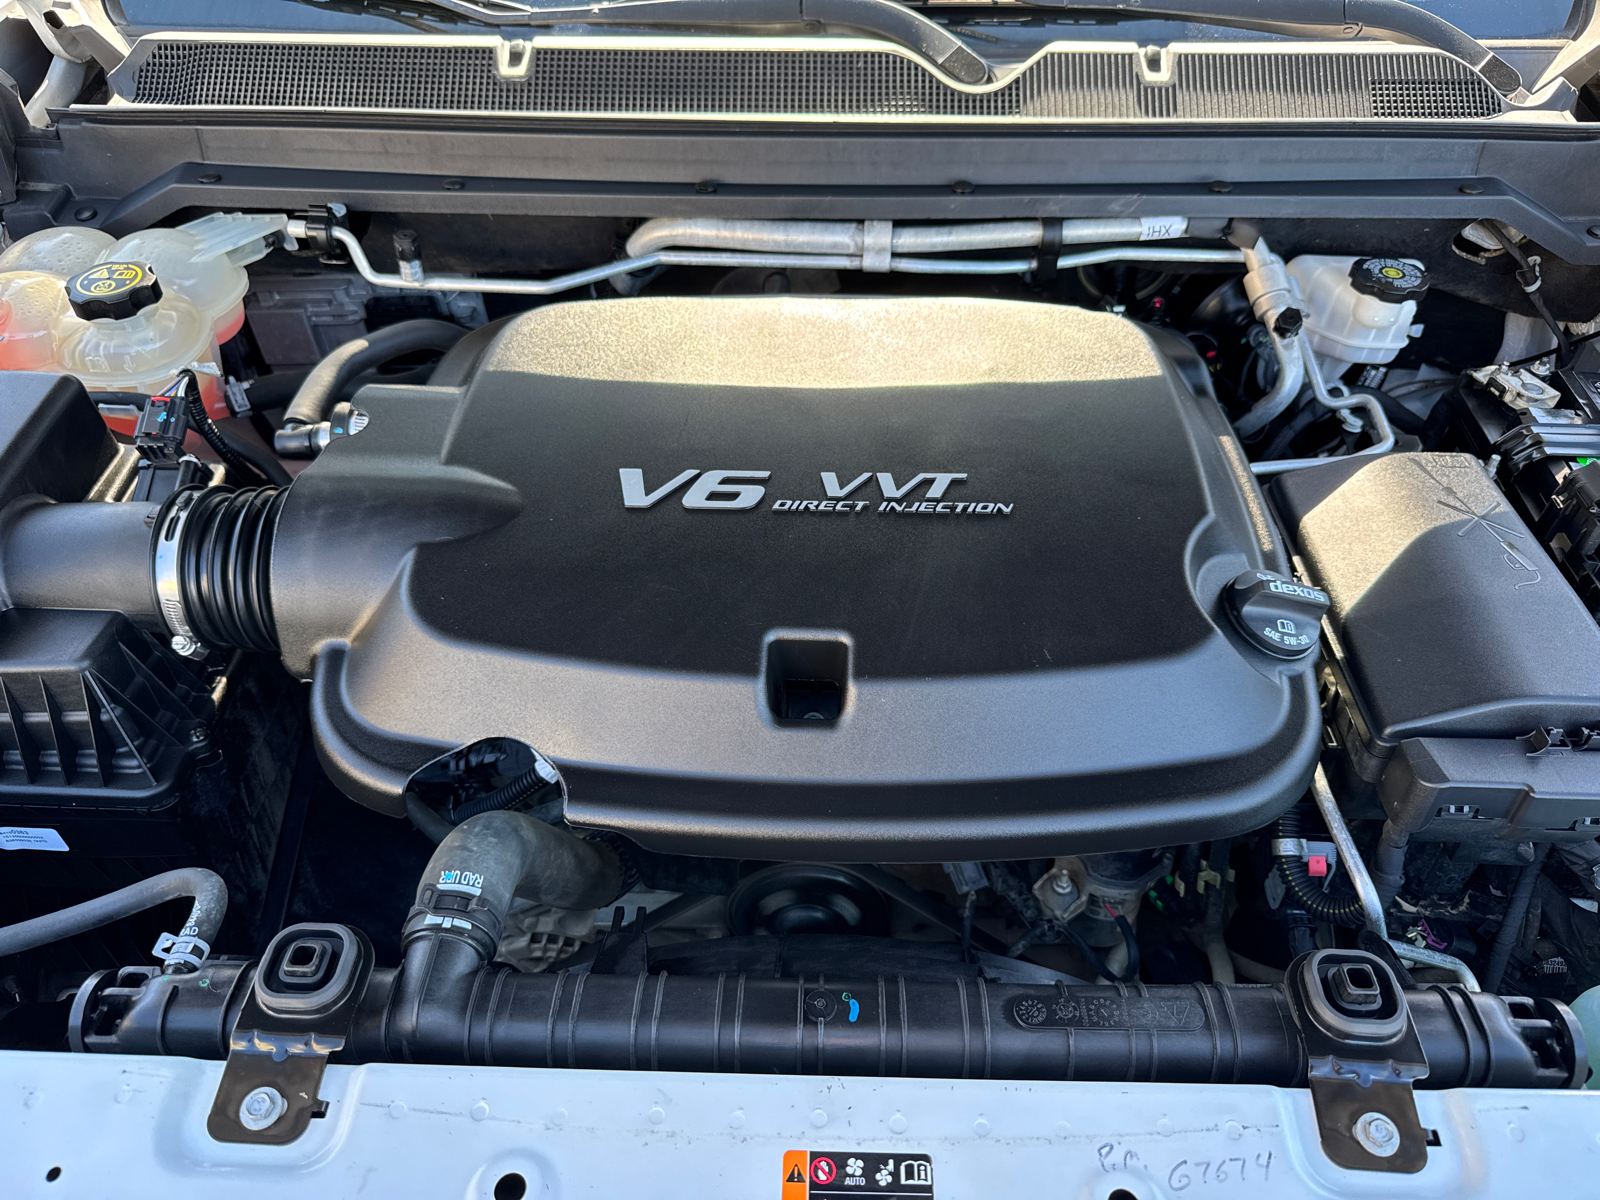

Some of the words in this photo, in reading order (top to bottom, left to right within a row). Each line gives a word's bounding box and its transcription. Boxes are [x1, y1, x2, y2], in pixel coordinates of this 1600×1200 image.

[619, 467, 772, 511] V6
[820, 471, 968, 500] VVT
[772, 499, 869, 513] DIRECT
[878, 500, 1014, 515] INJECTION
[1269, 581, 1325, 602] dexos
[1263, 627, 1282, 641] SAE
[1283, 634, 1309, 646] 5W-30
[460, 871, 484, 887] RAD
[844, 1176, 866, 1186] AUTO
